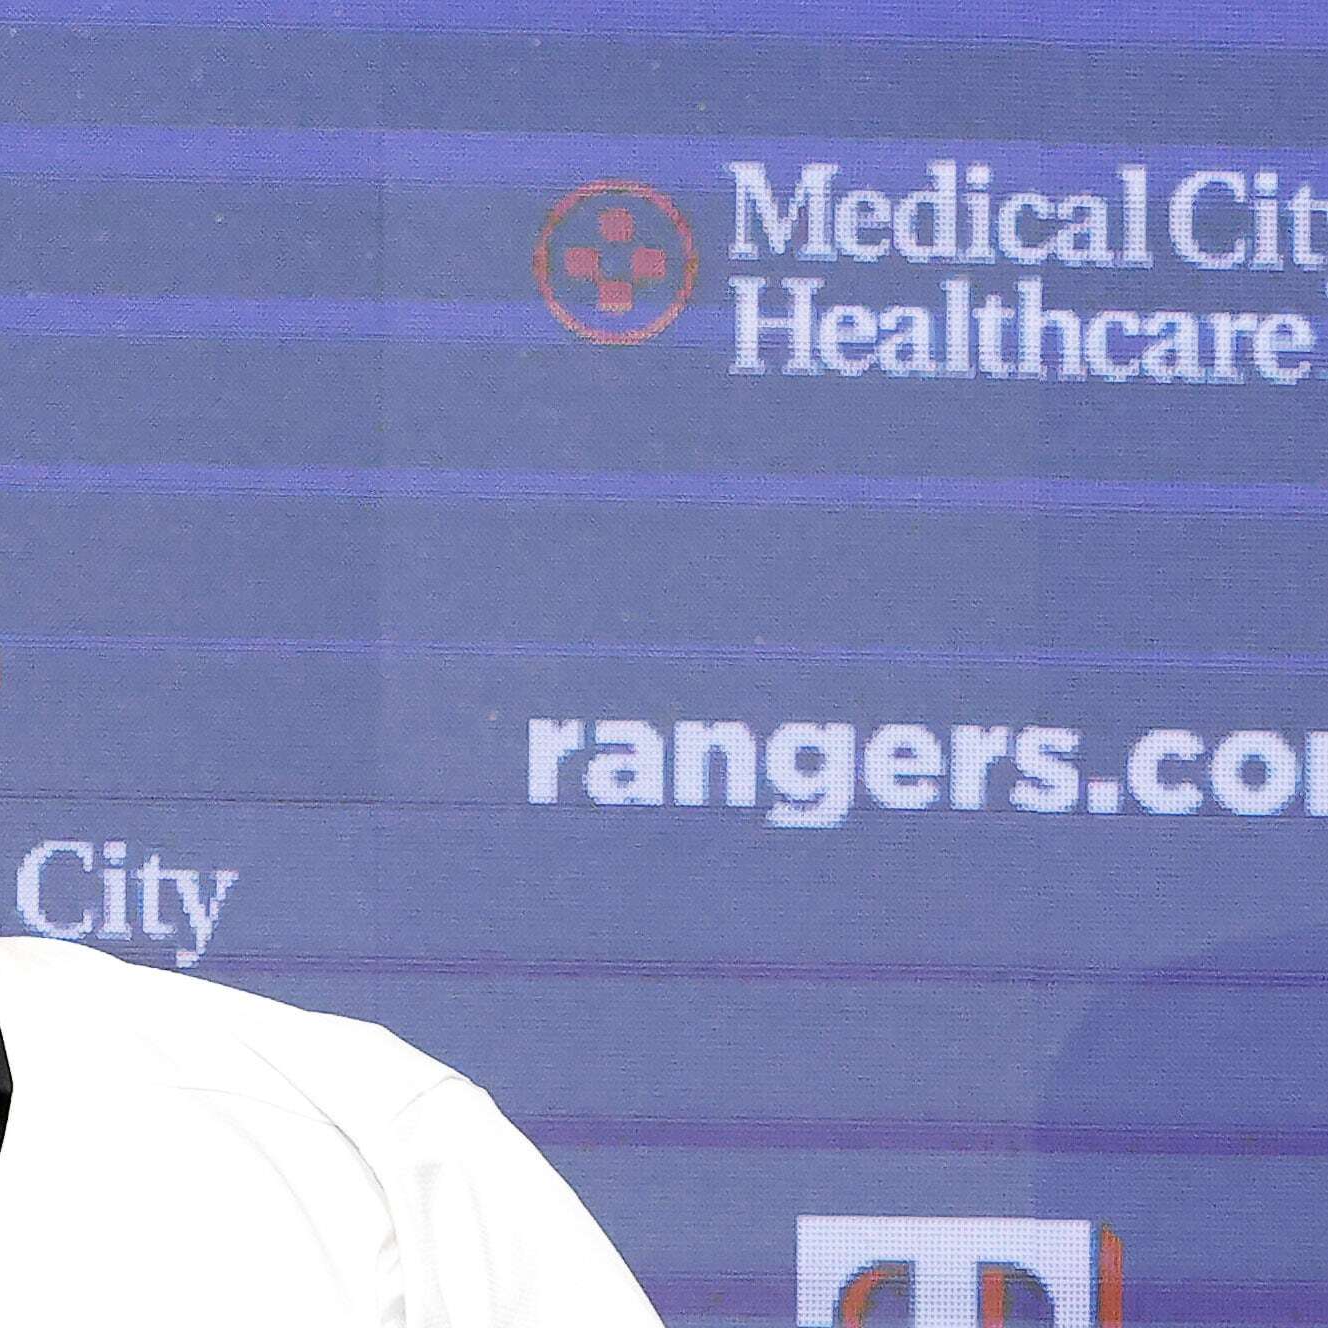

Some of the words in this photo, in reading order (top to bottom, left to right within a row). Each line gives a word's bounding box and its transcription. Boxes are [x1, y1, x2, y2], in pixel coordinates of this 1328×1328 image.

[728, 162, 1154, 270] Medical
[1168, 169, 1328, 297] Cit
[728, 275, 1315, 386] Healthcare
[527, 715, 1328, 829] rangers.co
[15, 840, 240, 968] City
